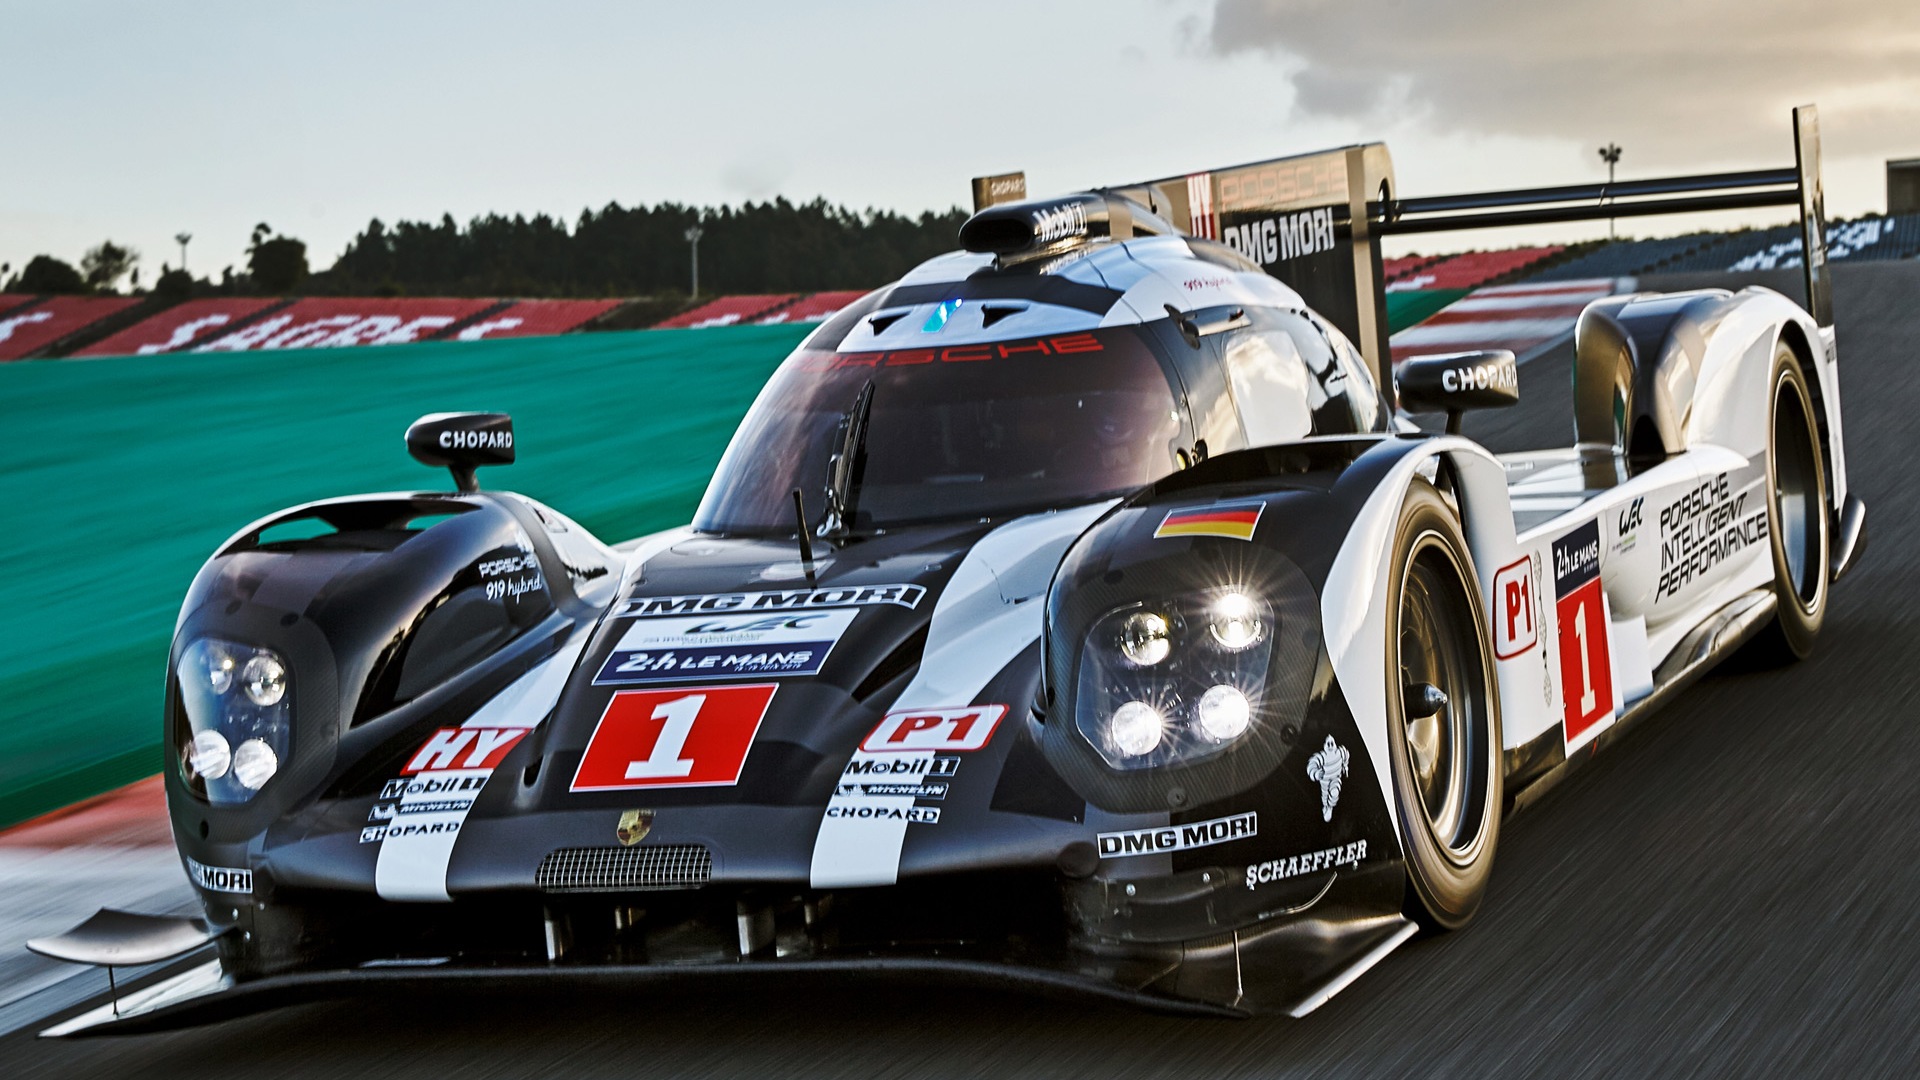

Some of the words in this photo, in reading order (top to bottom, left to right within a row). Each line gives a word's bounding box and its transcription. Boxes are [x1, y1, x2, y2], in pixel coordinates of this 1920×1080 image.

[1220, 160, 1347, 211] PORSCHE
[1032, 206, 1074, 241] Mobil
[1279, 207, 1335, 261] MORI
[1442, 364, 1517, 392] CHOPARD
[440, 431, 513, 449] CHOPARD
[1660, 472, 1729, 538] PORSCHE
[1661, 492, 1747, 571] INTELLIGENT
[479, 554, 538, 577] PORSCHE
[1570, 551, 1580, 572] LE
[1579, 540, 1598, 567] MANS
[1655, 512, 1768, 604] PERFORMANCE
[486, 579, 506, 600] 919
[507, 572, 543, 604] hybrid
[753, 587, 920, 609] MORI
[1505, 575, 1531, 642] P1
[680, 655, 722, 669] LE
[721, 651, 812, 667] MANS
[1575, 601, 1596, 718] 1
[624, 694, 707, 780] 1
[887, 713, 981, 744] P1
[407, 729, 526, 771] HY
[844, 758, 929, 775] Mobil
[381, 777, 458, 799] Mobil
[867, 786, 945, 795] MICHELIN
[400, 802, 470, 813] MICHELIN
[827, 807, 938, 822] CHOPARD
[362, 822, 460, 841] CHOPARD
[1100, 833, 1177, 855] DMG
[1183, 815, 1256, 847] MORI
[203, 867, 251, 889] MORI
[1246, 839, 1367, 885] SCHAEFFLER
